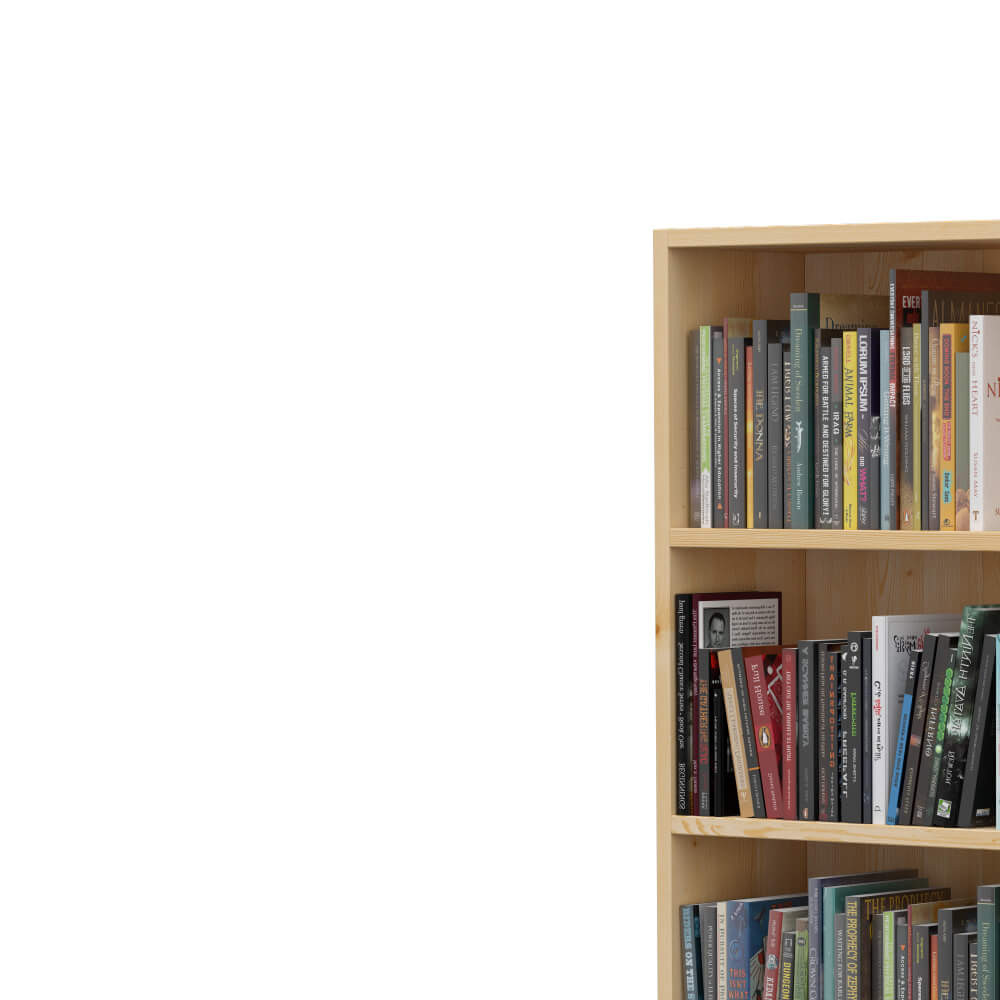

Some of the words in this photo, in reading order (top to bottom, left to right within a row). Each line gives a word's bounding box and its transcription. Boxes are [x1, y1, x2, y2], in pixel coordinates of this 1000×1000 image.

[847, 902, 857, 916] THE
[683, 908, 693, 950] RIDERS
[847, 918, 857, 960] PROPHECY
[685, 952, 693, 963] ON
[847, 963, 857, 973] OF
[686, 966, 694, 990] THE
[781, 962, 791, 999] DUNGEON
